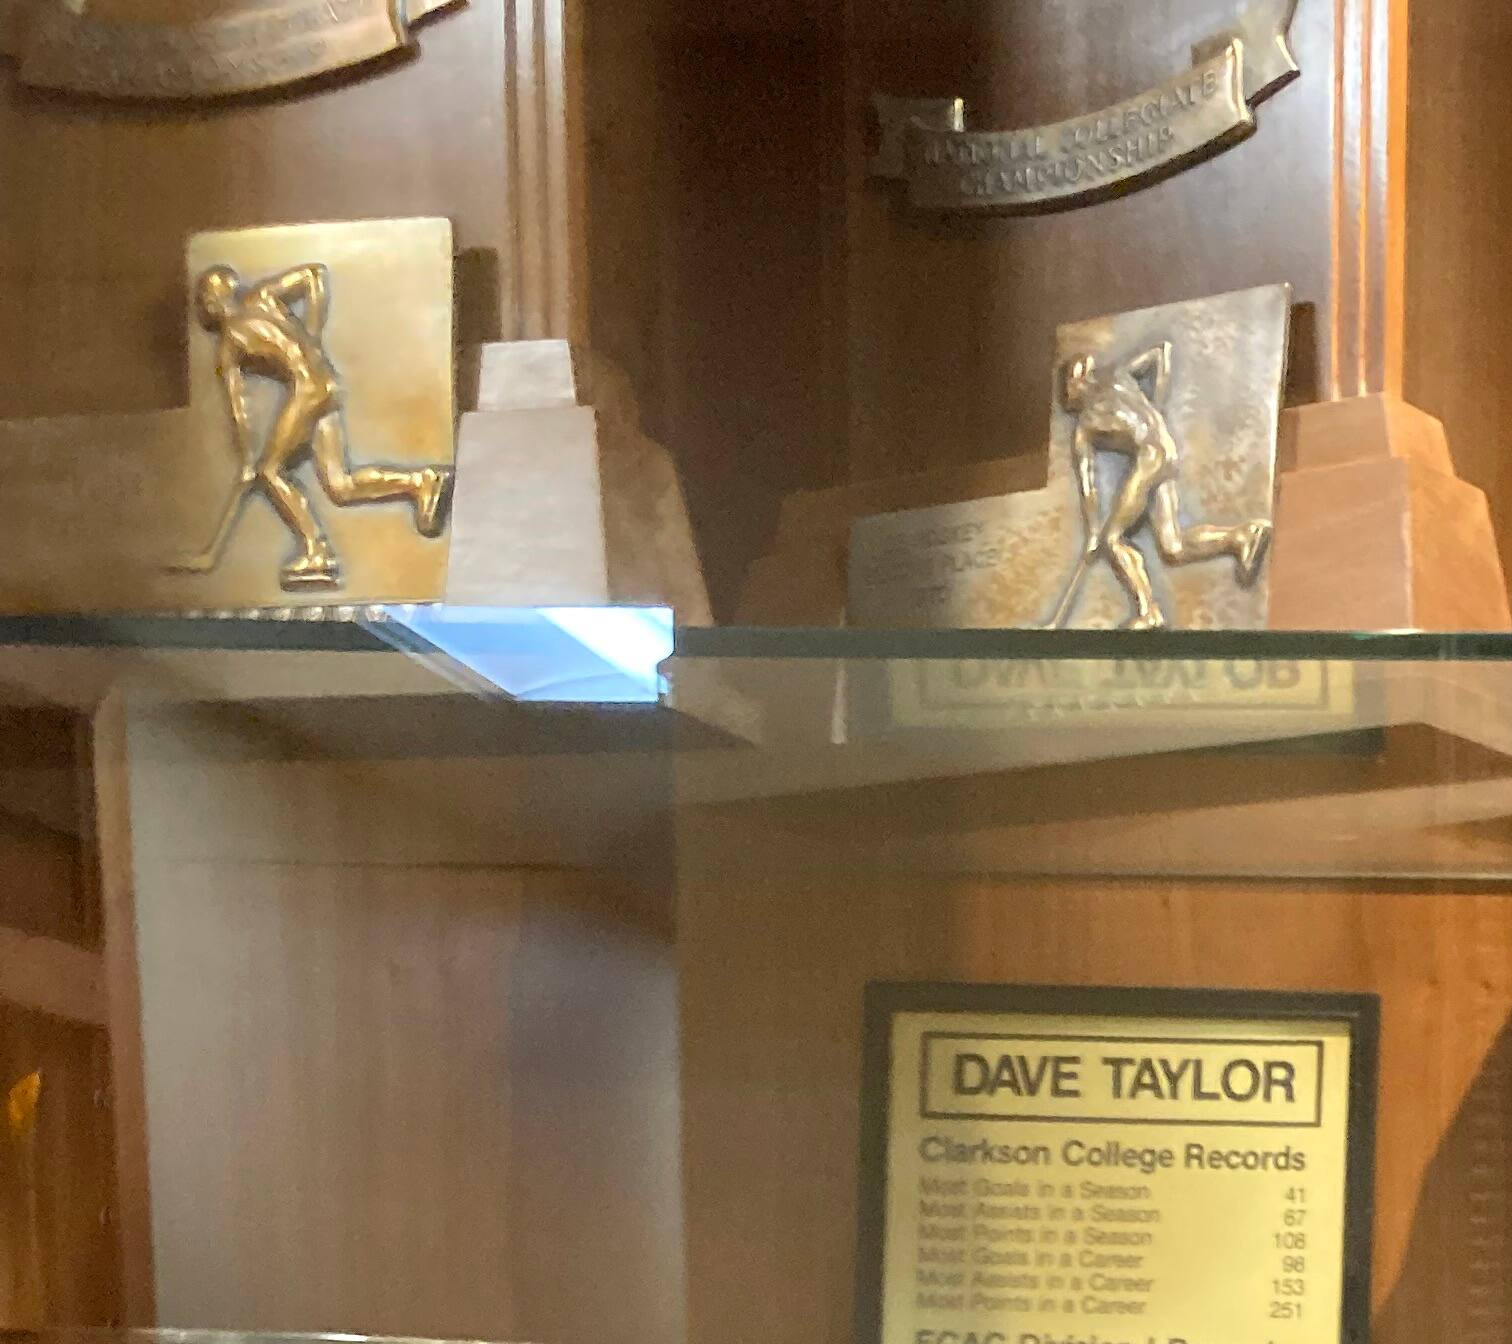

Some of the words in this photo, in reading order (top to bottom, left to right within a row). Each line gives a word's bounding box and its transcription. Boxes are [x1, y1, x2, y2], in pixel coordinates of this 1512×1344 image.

[953, 1052, 1081, 1099] DAVE
[1101, 1055, 1296, 1103] TAYLOR
[918, 1136, 1051, 1166] Clarkson
[1061, 1139, 1176, 1173] College
[1183, 1142, 1307, 1172] Records
[1080, 1180, 1152, 1200] Season
[1284, 1187, 1306, 1204] 41
[1090, 1203, 1161, 1224] Season
[1283, 1208, 1307, 1227] 67
[1083, 1226, 1153, 1246] Season
[1273, 1231, 1306, 1250] 108
[1282, 1255, 1305, 1274] 98
[1272, 1278, 1305, 1297] 153
[1270, 1301, 1303, 1320] 251
